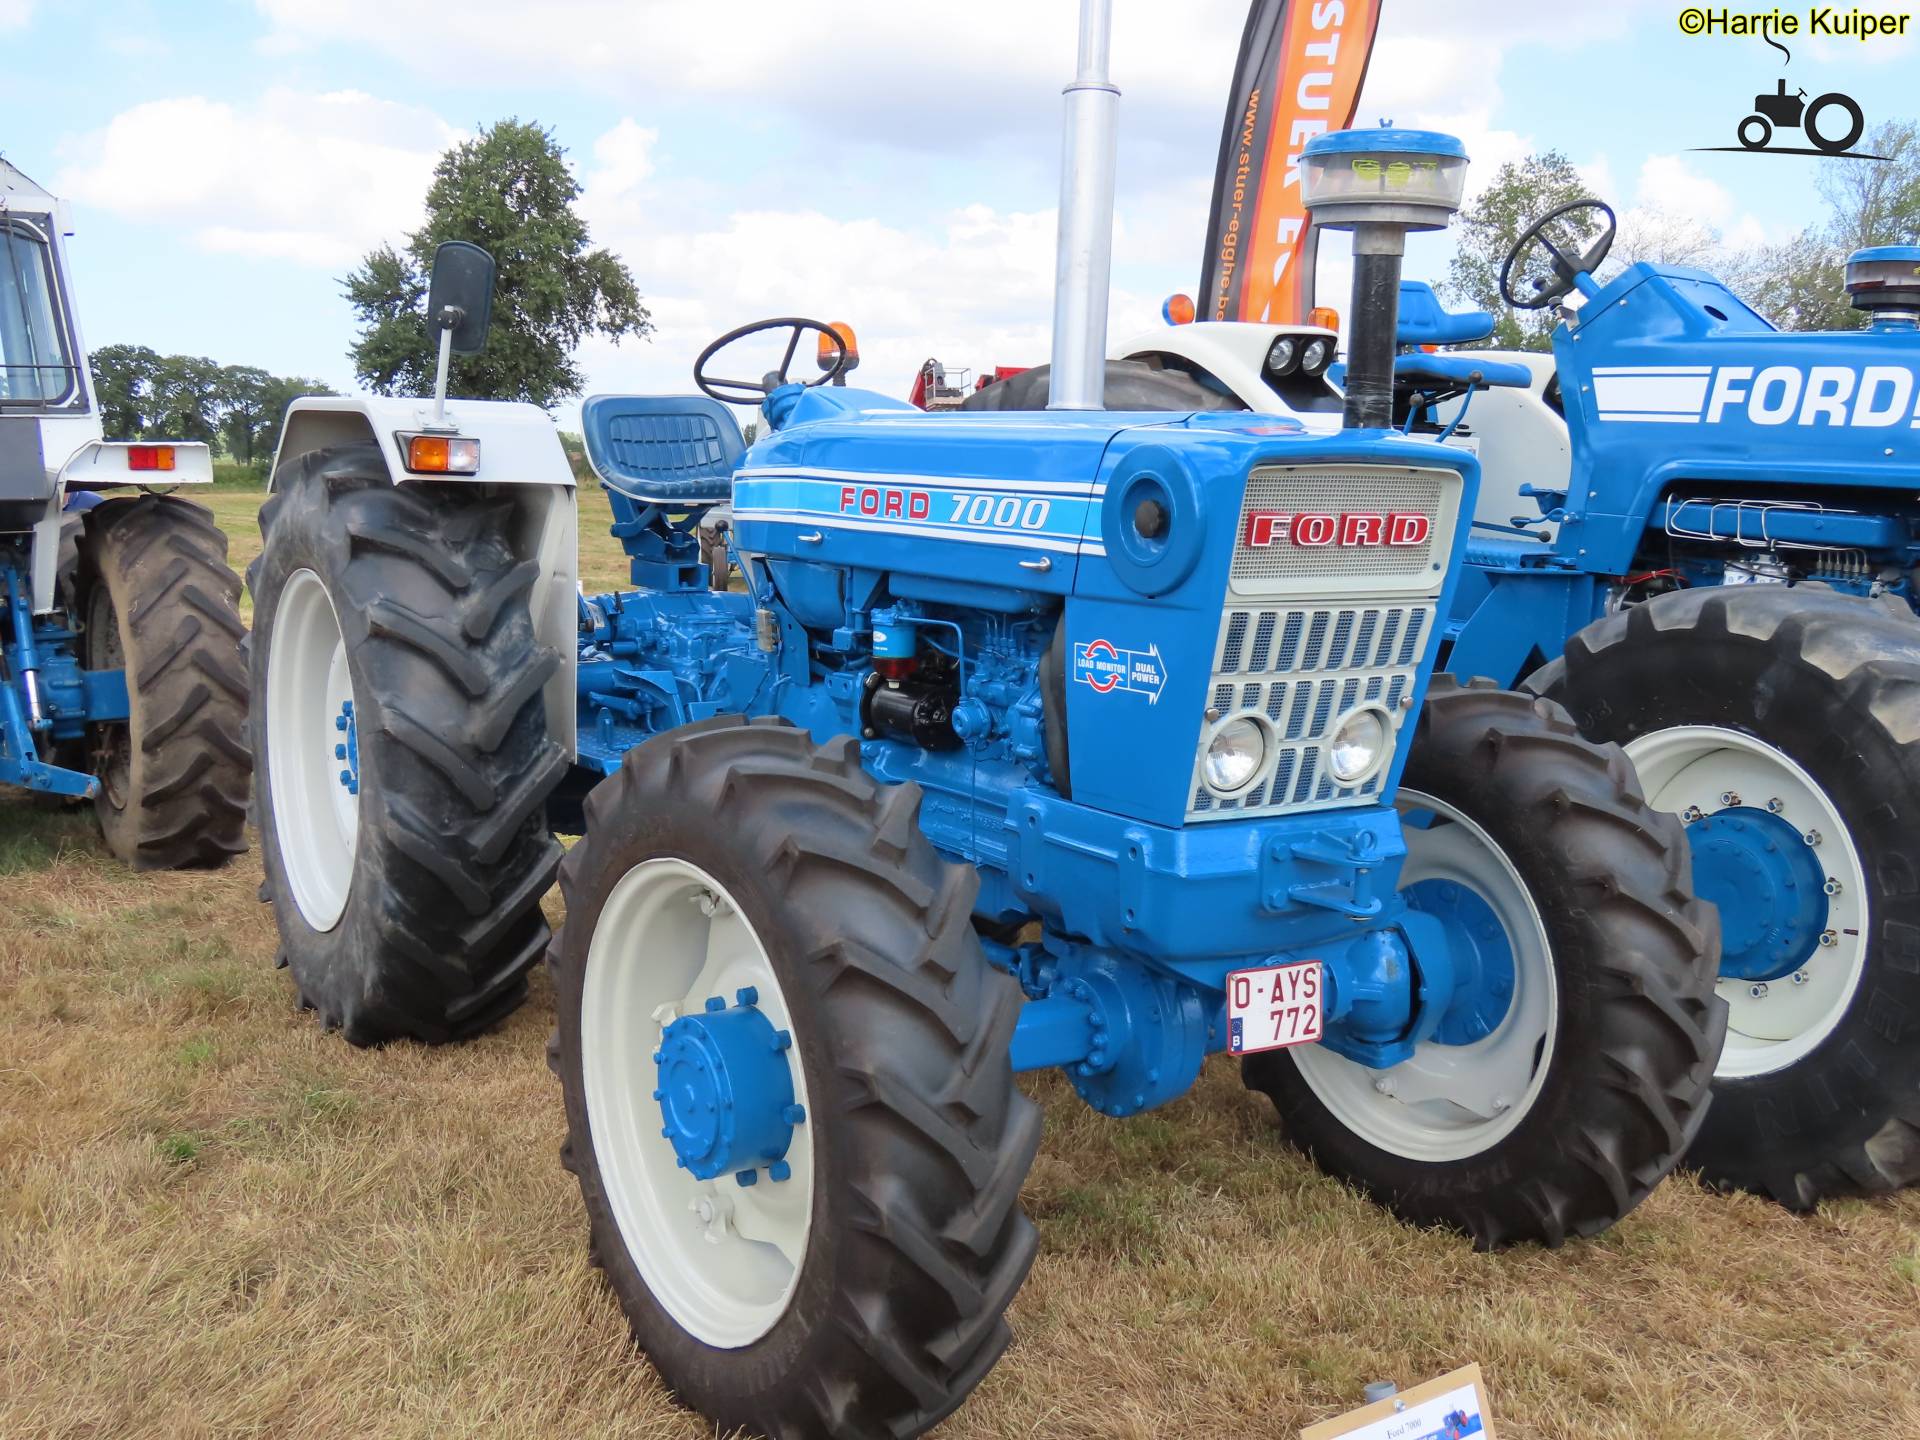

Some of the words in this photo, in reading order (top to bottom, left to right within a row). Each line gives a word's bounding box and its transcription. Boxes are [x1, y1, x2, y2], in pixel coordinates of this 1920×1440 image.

[1706, 366, 1914, 427] FORD
[840, 486, 930, 520] FORD
[949, 494, 1051, 530] 7000
[1245, 509, 1430, 547] FORD
[1078, 658, 1094, 669] LOAD
[1096, 661, 1126, 674] MONITOR
[1132, 672, 1160, 685] POWER
[1136, 662, 1156, 674] DUAL
[1270, 1004, 1317, 1041] 772
[1232, 1035, 1240, 1047] B
